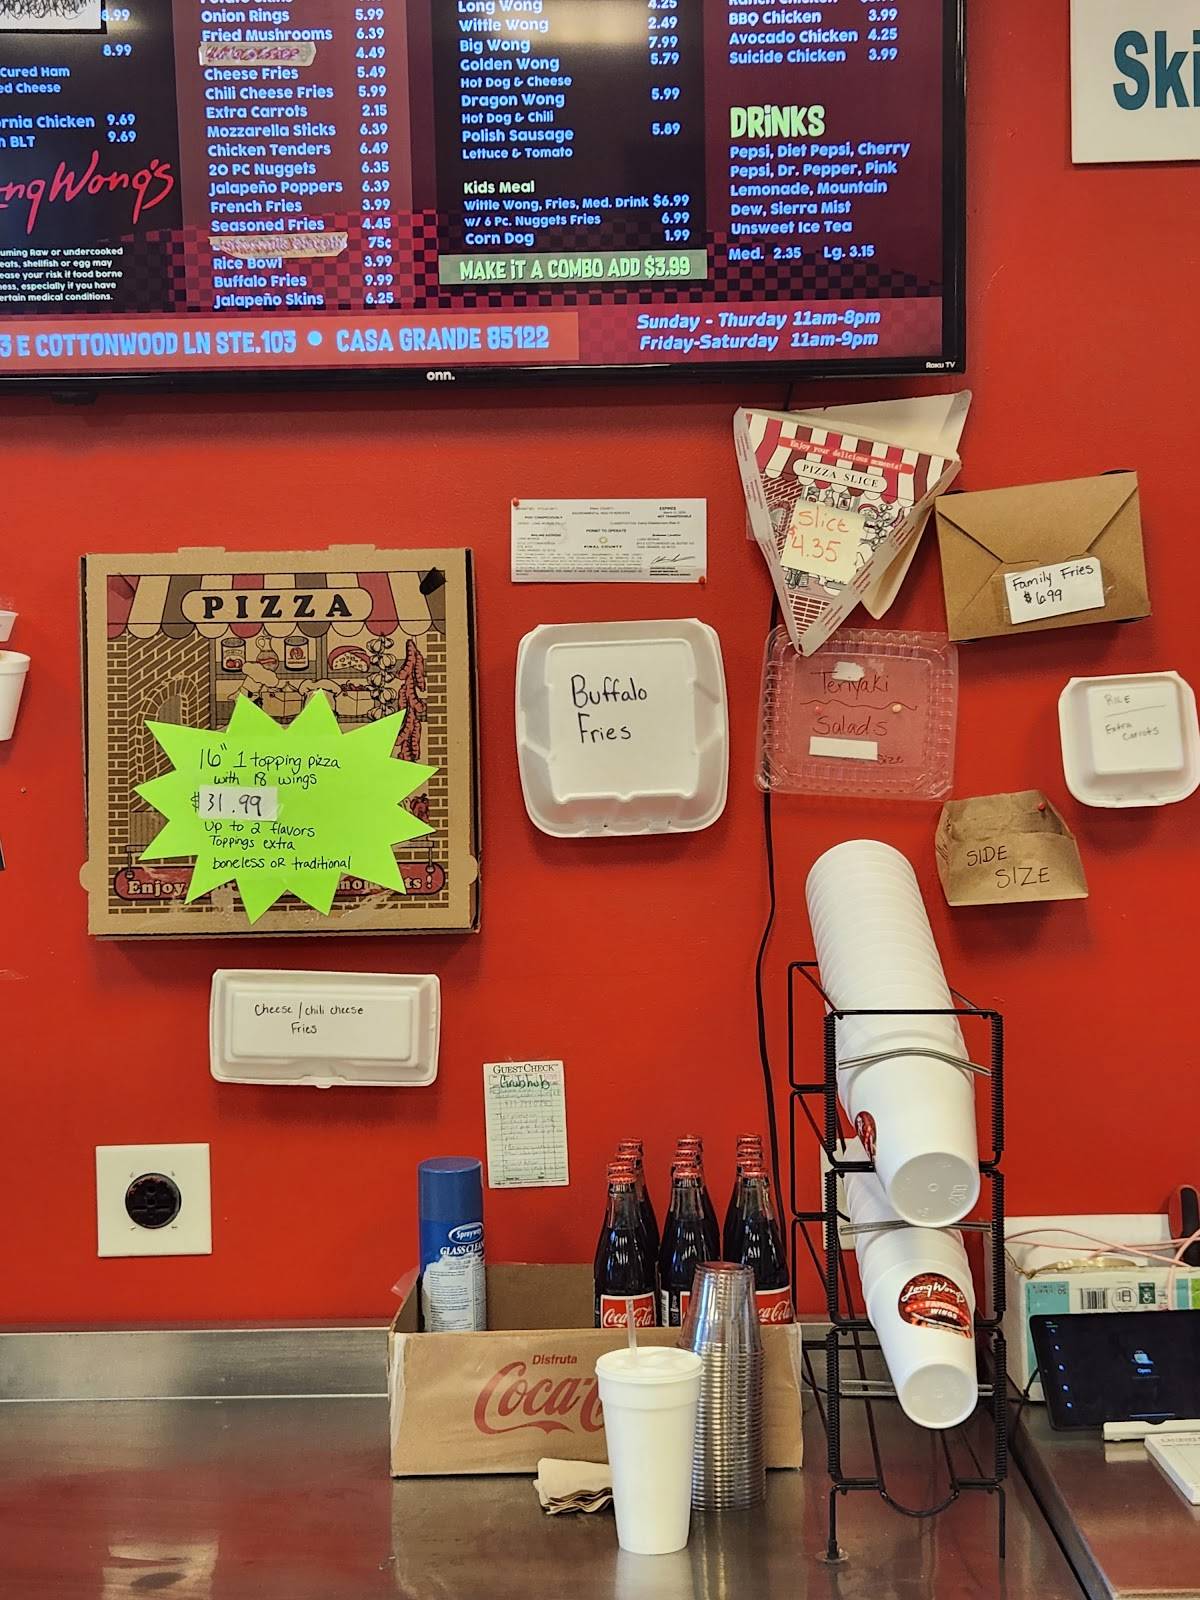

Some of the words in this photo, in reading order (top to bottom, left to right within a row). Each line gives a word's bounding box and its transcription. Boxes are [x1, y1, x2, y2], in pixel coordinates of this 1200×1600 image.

[201, 9, 245, 23] Onion
[249, 8, 289, 24] Rings
[355, 8, 384, 21] 5.99
[729, 12, 759, 26] BBQ
[763, 11, 822, 24] Chicken
[868, 9, 897, 21] 3.99
[459, 19, 501, 32] Wittle
[506, 19, 549, 33] Wong
[648, 16, 678, 29] 2.49
[202, 28, 242, 42] Fried
[246, 28, 333, 42] Mushrooms
[356, 27, 384, 39] 6.39
[103, 45, 132, 56] 8.99
[41, 67, 70, 77] Ham
[205, 86, 236, 100] Chili
[240, 87, 293, 100] Cheese
[297, 85, 333, 98] Fries
[358, 85, 386, 97] 5.99
[462, 94, 518, 109] Dragon
[521, 93, 564, 108] Wong
[651, 88, 680, 100] 5.99
[37, 115, 95, 127] Chicken
[208, 124, 289, 138] Mozzarella
[293, 123, 336, 136] Sticks
[360, 123, 388, 135] 6.39
[10, 136, 35, 148] BLT
[730, 146, 774, 160] Pepsi,
[777, 144, 807, 157] Diet
[811, 143, 854, 158] Pepsi,
[858, 143, 910, 158] Cherry
[464, 181, 495, 194] Kids
[499, 180, 534, 193] Meal
[211, 201, 262, 213] French
[266, 199, 302, 212] Fries
[362, 199, 390, 211] 3.99
[464, 200, 499, 211] Wittle
[503, 200, 542, 212] Wong,
[545, 199, 579, 210] Fries,
[583, 197, 612, 209] Med.
[615, 196, 649, 208] Drink
[653, 194, 689, 207] $6.99
[731, 222, 795, 235] Unsweet
[798, 222, 820, 233] Ice
[824, 221, 852, 232] Tea
[465, 233, 500, 245] Corn
[505, 232, 534, 247] Dog
[664, 230, 690, 241] 1.99
[729, 247, 764, 260] Med.
[773, 247, 801, 259] 2.35
[824, 246, 845, 260] Lg.
[850, 245, 874, 258] 3.15
[22, 272, 43, 280] your
[46, 270, 62, 279] risk
[64, 270, 70, 278] if
[96, 270, 122, 278] borne
[459, 261, 506, 280] MAKE
[531, 262, 543, 279] A
[548, 258, 604, 279] COMBO
[607, 259, 640, 277] ADD
[645, 255, 691, 278] $3.99
[28, 293, 63, 301] medical
[65, 292, 113, 300] conditions.
[214, 294, 281, 308] Jalapeño
[286, 293, 324, 305] Skins
[366, 292, 394, 304] 6.25
[637, 314, 699, 332] Sunday
[718, 312, 786, 330] Thurday
[792, 310, 880, 327] 11am-8pm
[18, 336, 30, 356] E
[36, 332, 178, 357] COTTONWOOD
[183, 331, 210, 354] LN
[336, 329, 394, 352] CASA
[400, 327, 481, 351] GRANDE
[487, 326, 549, 349] 85122
[640, 334, 778, 353] Friday-Saturday
[791, 331, 878, 349] 11am-9pm
[427, 370, 455, 381] onn.
[790, 440, 810, 451] Enjoy
[833, 450, 868, 462] delicious
[802, 465, 836, 479] PIZZA
[844, 474, 878, 487] SLICE
[1013, 571, 1052, 591] Family
[1060, 564, 1093, 580] Fries
[202, 594, 352, 619] PIZZA
[571, 674, 648, 708] Buffalo
[810, 670, 889, 699] Teriyaki
[578, 712, 631, 744] Fries
[813, 715, 888, 736] Salads
[234, 751, 247, 768] 1
[250, 752, 301, 774] topping
[308, 756, 340, 768] pizza
[214, 772, 240, 785] with
[254, 773, 267, 786] 18
[278, 773, 317, 789] wings
[230, 821, 244, 832] to
[251, 823, 260, 834] 2
[271, 822, 315, 837] flavors
[210, 835, 255, 850] Toppings
[264, 839, 295, 850] extra
[213, 857, 265, 870] boneless
[293, 857, 351, 870] traditional
[967, 845, 1007, 866] SIDE
[995, 866, 1050, 888] SIZE
[128, 880, 186, 896] Enjoy
[330, 1006, 364, 1015] cheese
[291, 1022, 317, 1034] Fries
[440, 1246, 466, 1255] GLASS
